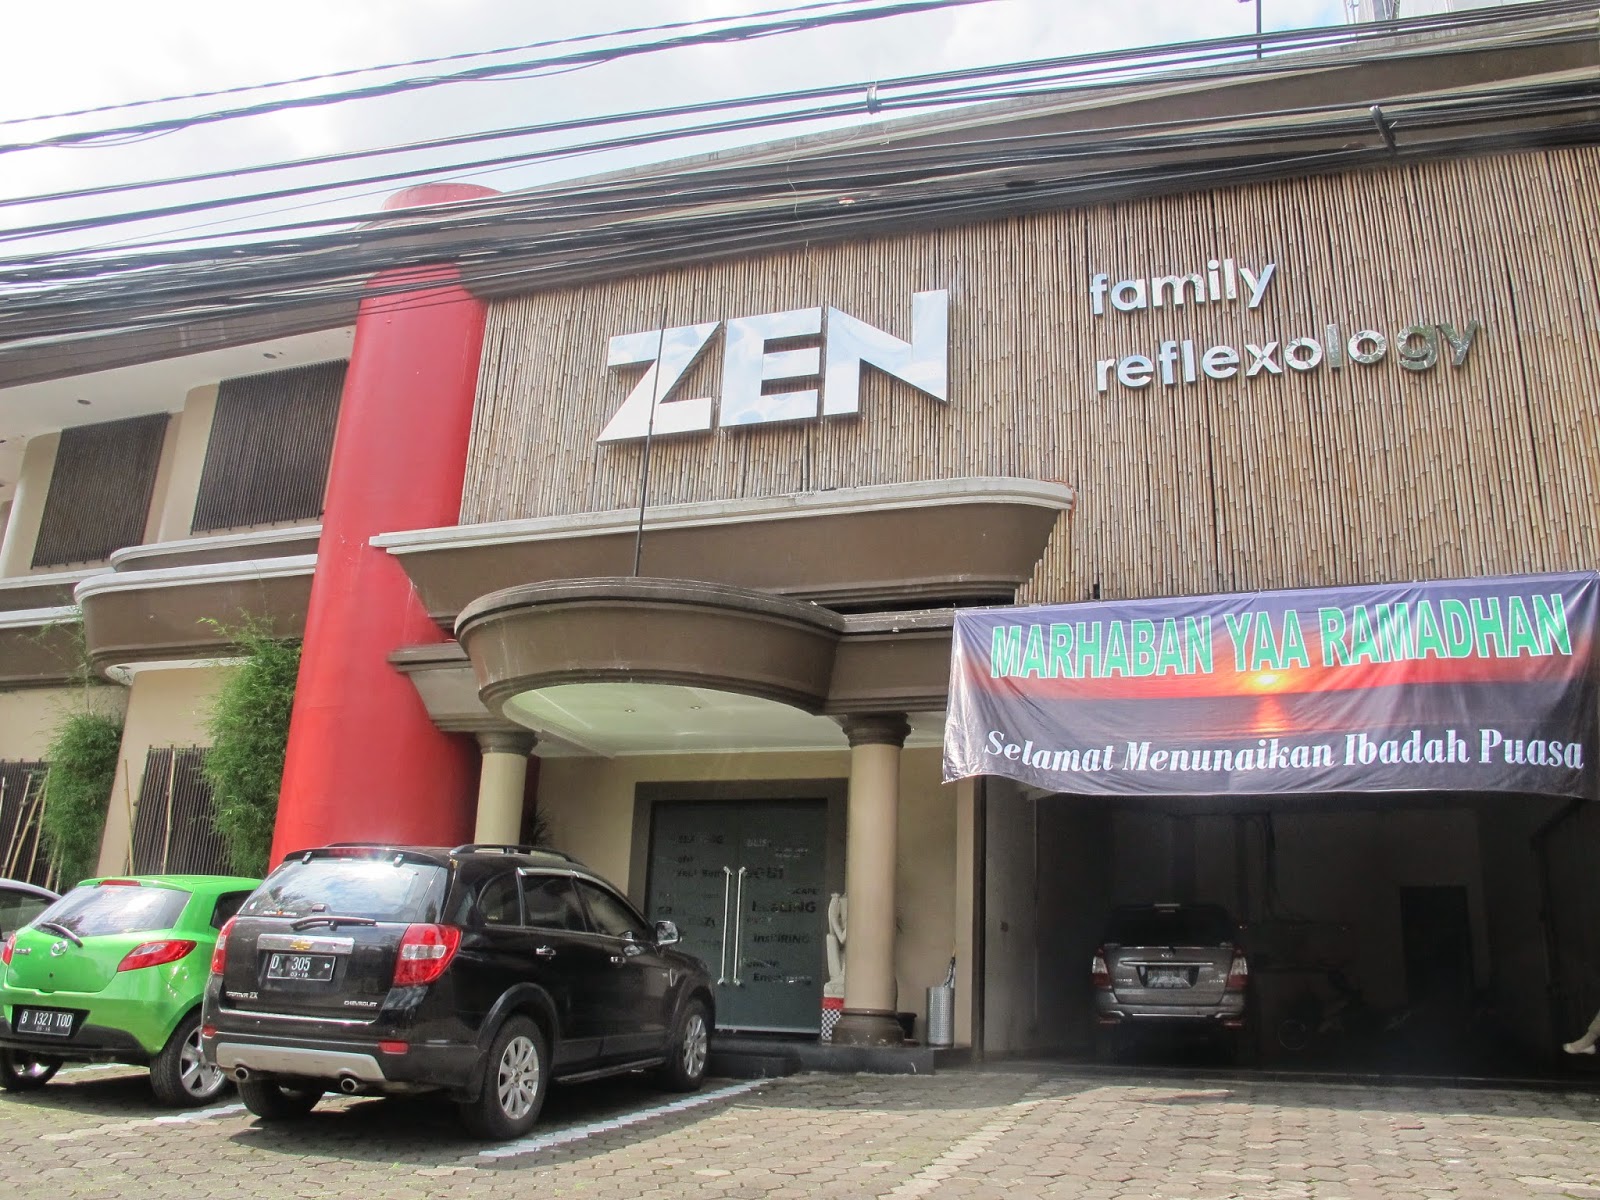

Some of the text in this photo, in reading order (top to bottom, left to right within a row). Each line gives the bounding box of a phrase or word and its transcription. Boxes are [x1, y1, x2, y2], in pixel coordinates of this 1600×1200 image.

[1090, 258, 1276, 315] family
[596, 288, 948, 442] ZEN
[1096, 319, 1478, 392] reflexology
[990, 593, 1572, 679] MARHABAN YAA RAMADHAN
[984, 728, 1584, 772] Selamat Menunaikan Ibadah Puasa
[272, 955, 311, 971] D 305
[22, 1011, 28, 1024] B
[34, 1012, 53, 1026] 1321
